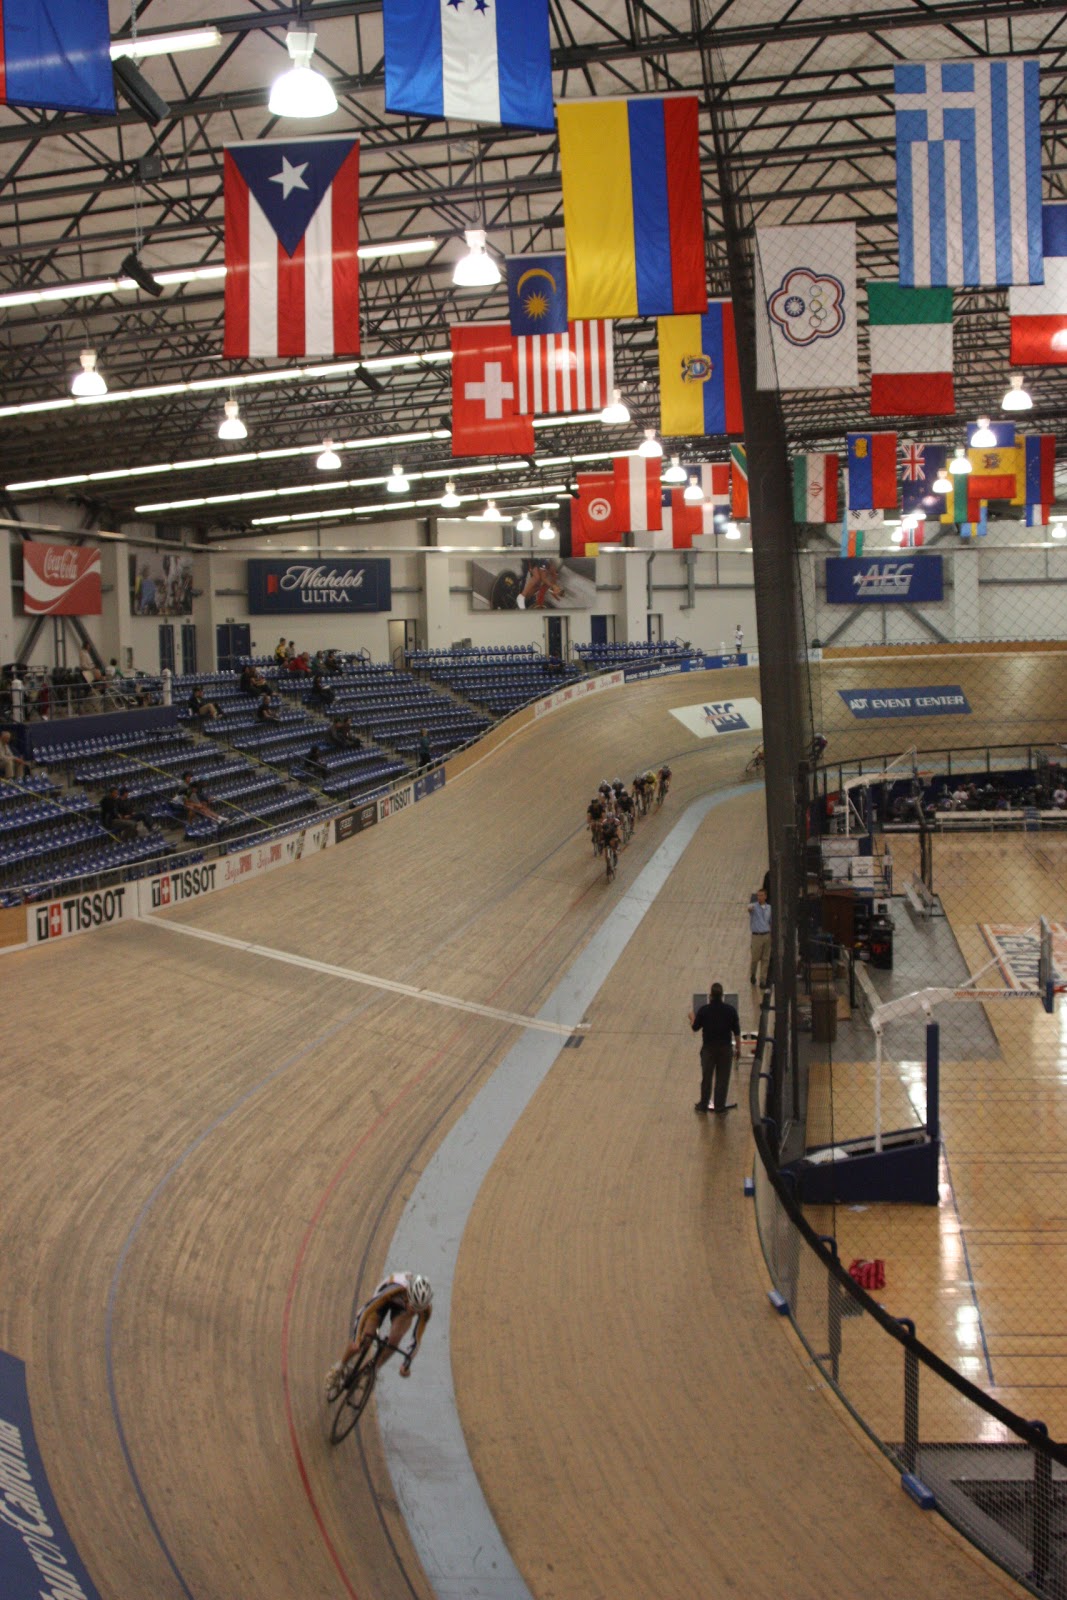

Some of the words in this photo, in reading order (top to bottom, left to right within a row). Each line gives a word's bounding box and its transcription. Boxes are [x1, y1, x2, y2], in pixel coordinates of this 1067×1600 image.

[280, 565, 366, 590] Michelob
[861, 563, 915, 587] AEG
[301, 589, 350, 603] ULTRA
[703, 702, 745, 726] AEG
[850, 698, 868, 711] ADT
[872, 697, 912, 709] EVENT
[915, 695, 965, 707] CENTER
[389, 787, 411, 814] TISSOT
[171, 863, 217, 901] TISSOT
[63, 888, 125, 932] TISSOT
